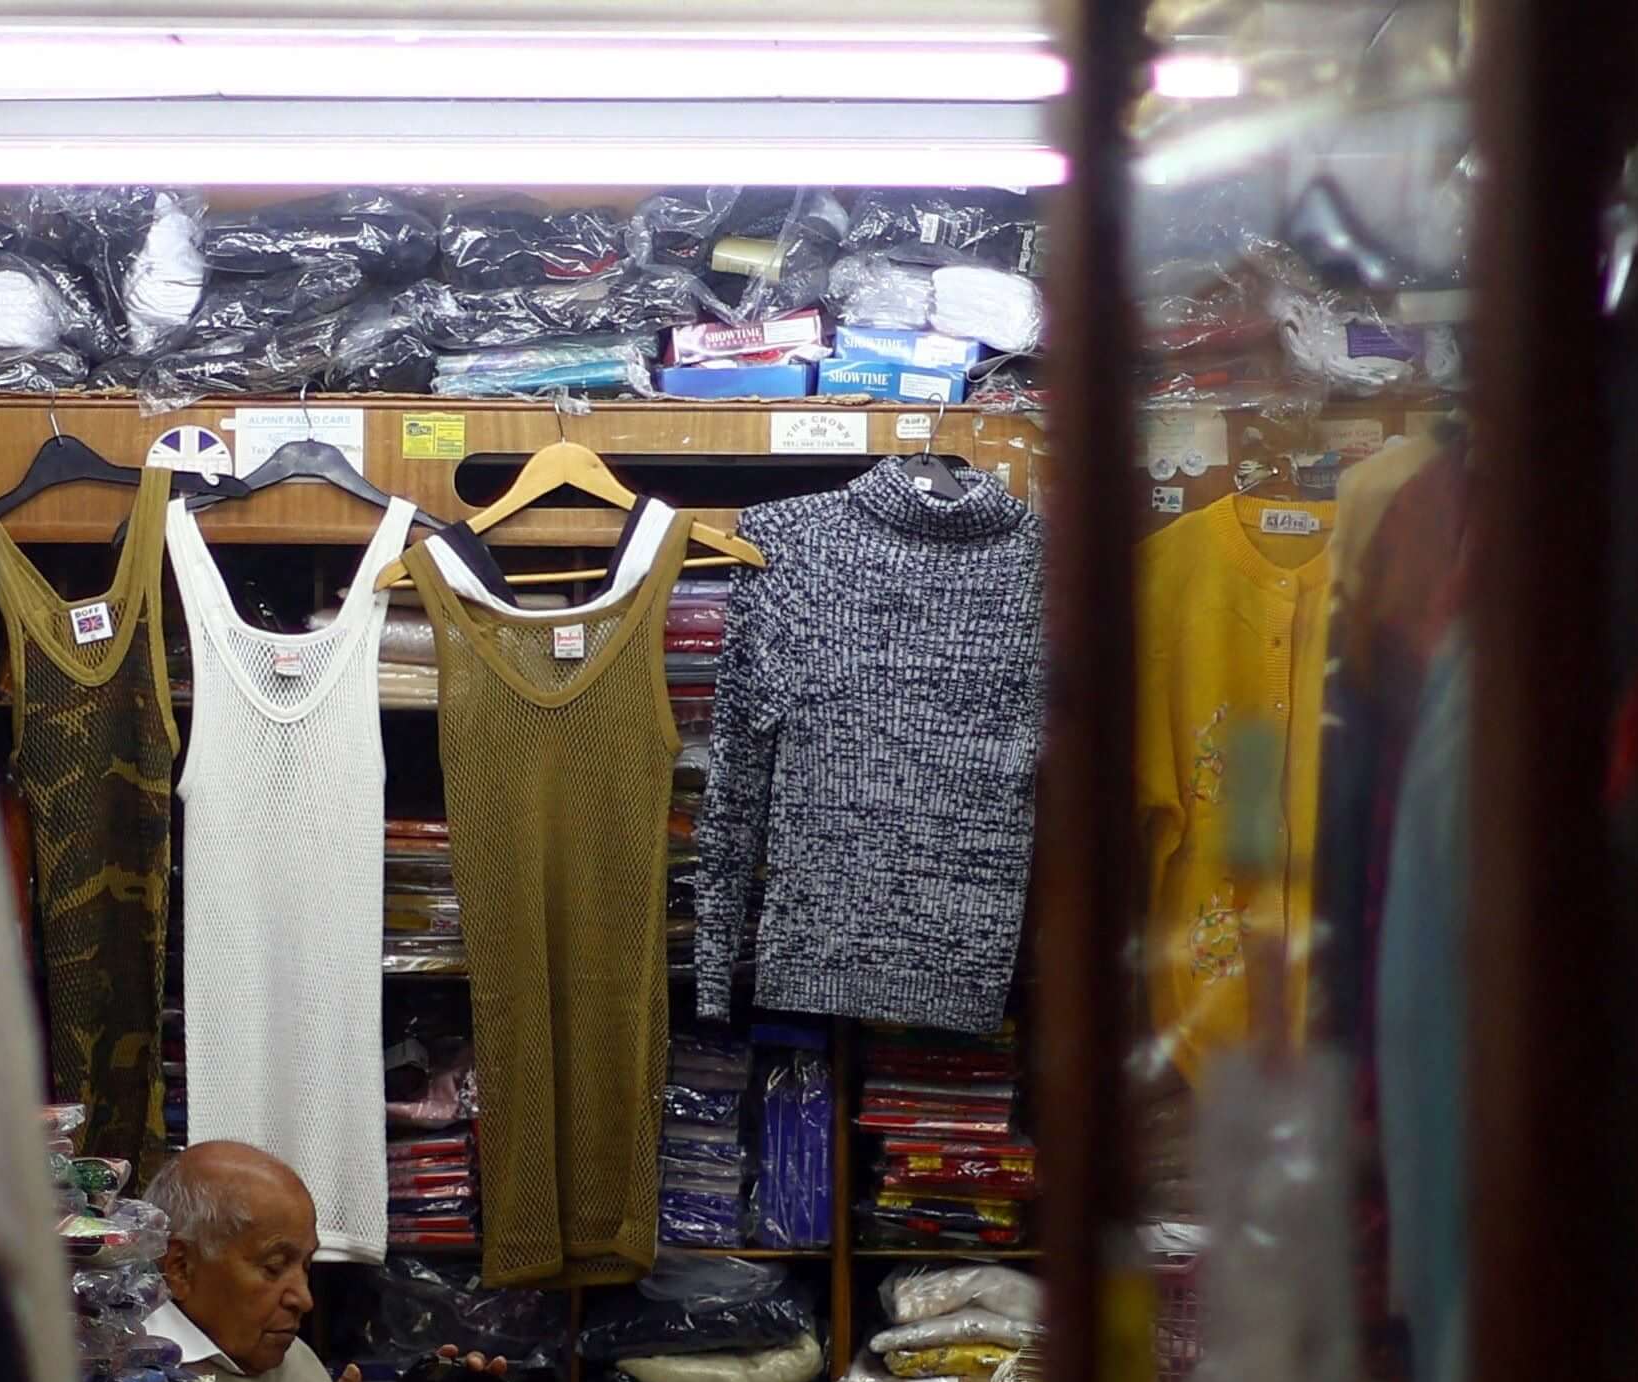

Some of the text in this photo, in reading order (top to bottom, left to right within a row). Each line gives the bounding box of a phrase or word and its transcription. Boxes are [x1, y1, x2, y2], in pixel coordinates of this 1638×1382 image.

[705, 328, 763, 342] SHOWTIME
[829, 371, 889, 385] SHOWTIME
[787, 416, 851, 438] THE CROWN
